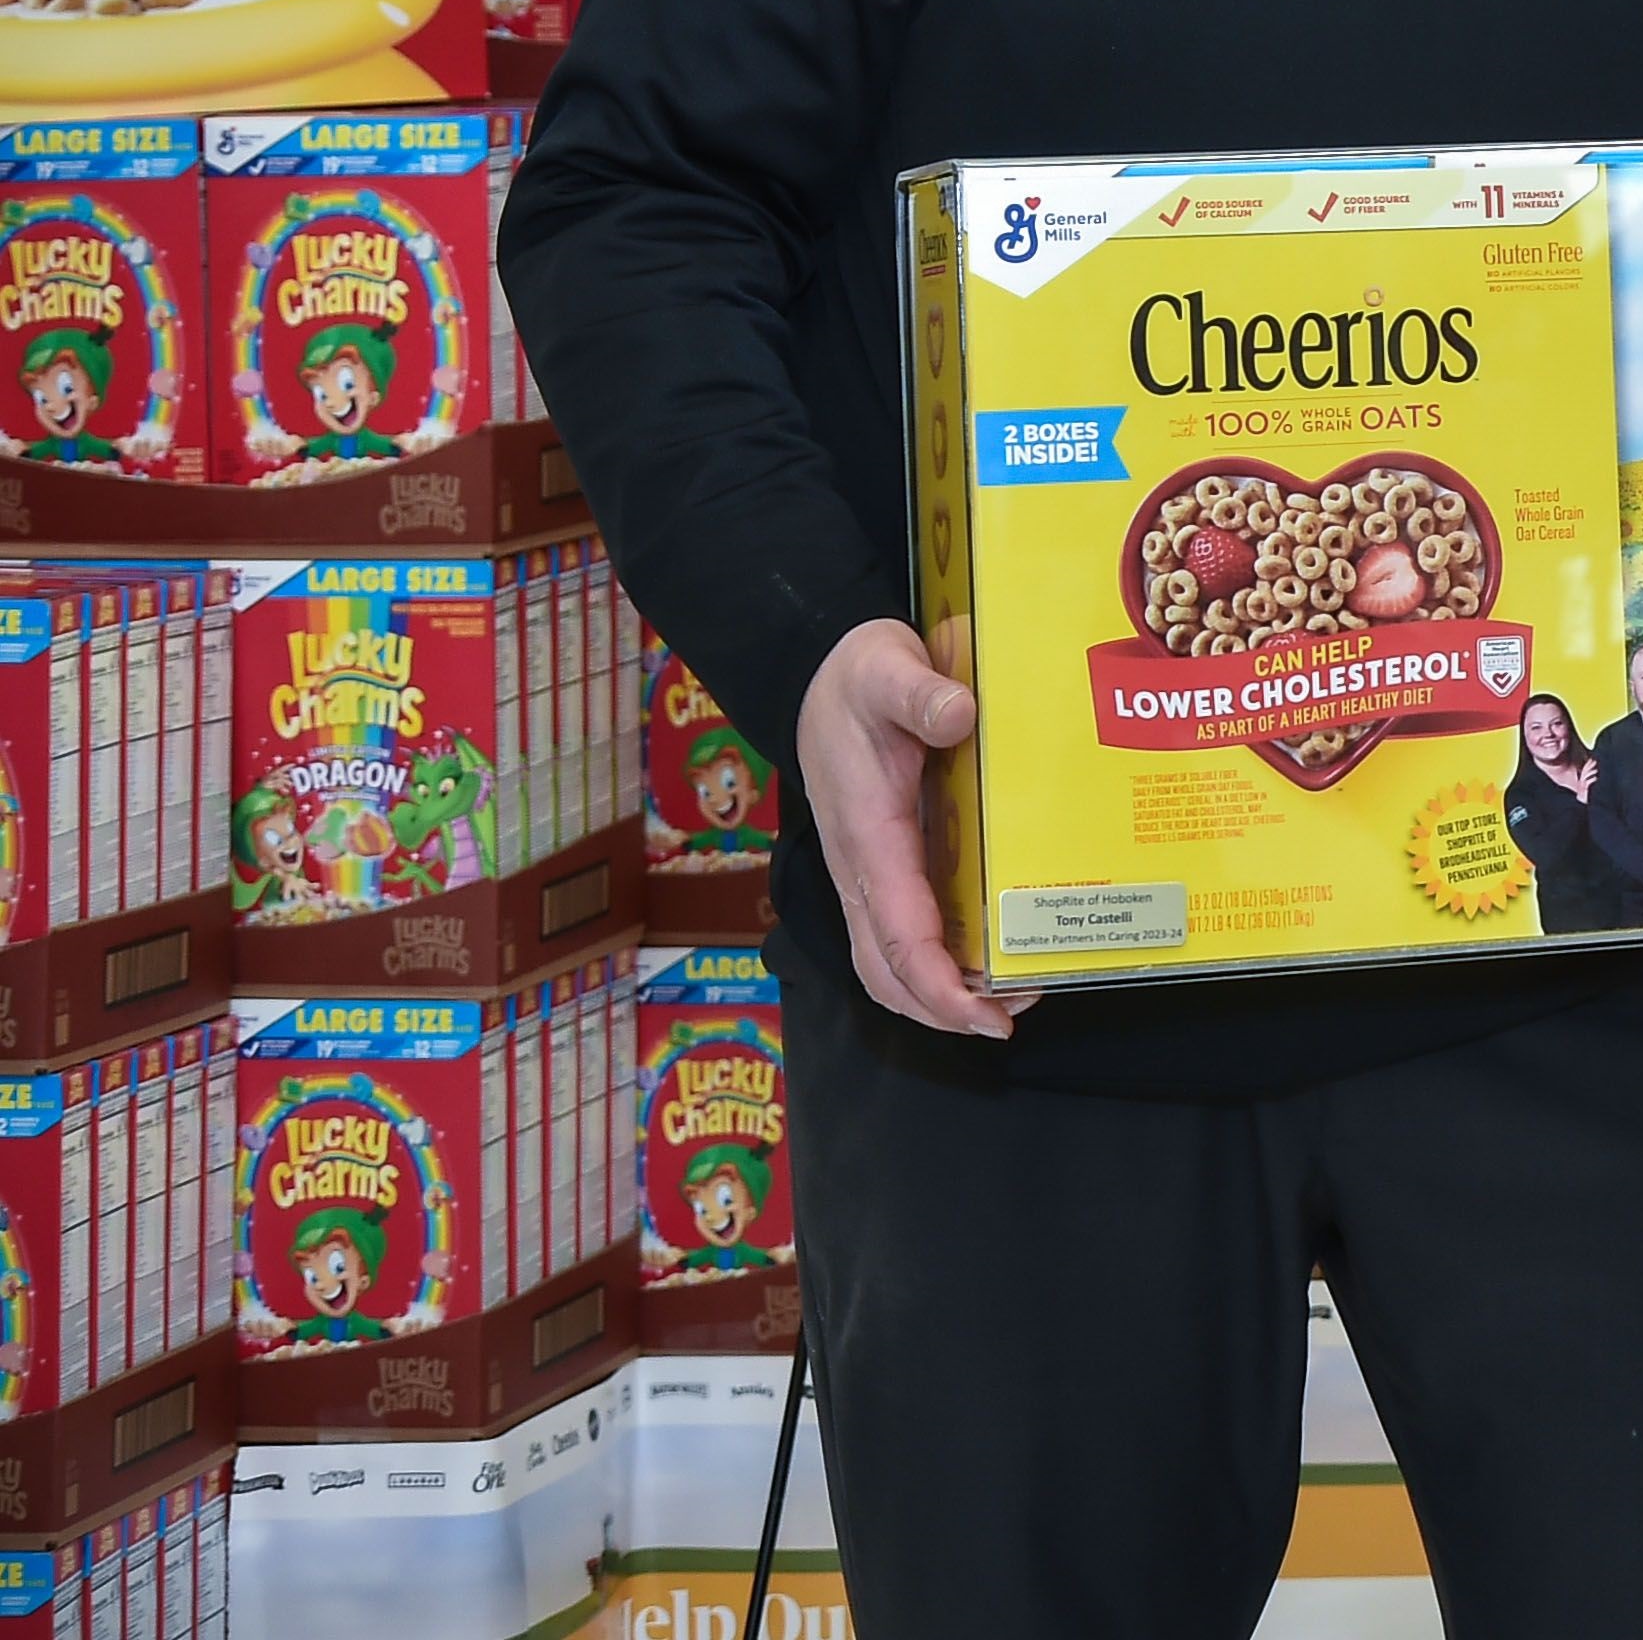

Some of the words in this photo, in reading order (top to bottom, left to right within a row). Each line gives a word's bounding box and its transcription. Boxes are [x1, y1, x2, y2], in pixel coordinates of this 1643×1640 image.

[1044, 212, 1107, 226] General
[1044, 228, 1081, 241] Mills
[292, 231, 399, 286] Lucky
[1483, 243, 1541, 265] Gluten
[1546, 243, 1583, 263] Free
[276, 274, 408, 329] Charms
[1130, 287, 1478, 396] Cheerios
[1205, 410, 1293, 437] 100%
[1361, 405, 1442, 431] OATS
[1301, 408, 1352, 419] WHOLE
[1302, 419, 1352, 433] GRAIN
[1005, 426, 1017, 443] 2
[1023, 423, 1099, 444] BOXES
[1005, 443, 1098, 466] INSIDE!
[287, 628, 413, 689] Lucky
[1254, 655, 1307, 677] CAN
[1312, 636, 1373, 667] HELP
[1115, 684, 1234, 720] LOWER
[1240, 652, 1467, 710] CHOLESTEROL
[271, 684, 425, 744] Charms
[1197, 721, 1216, 740] AS
[1220, 717, 1255, 738] PART
[1259, 715, 1276, 734] OF
[1279, 712, 1289, 729] A
[1294, 703, 1337, 727] HEART
[1341, 692, 1399, 721] HEALTHY
[1403, 687, 1432, 708] DIET
[290, 754, 406, 794] DRAGON
[1034, 896, 1083, 910] ShopRite
[1085, 895, 1097, 906] of
[1099, 891, 1152, 905] Hoboken
[1055, 913, 1087, 928] Tony
[1091, 911, 1133, 925] Castelli
